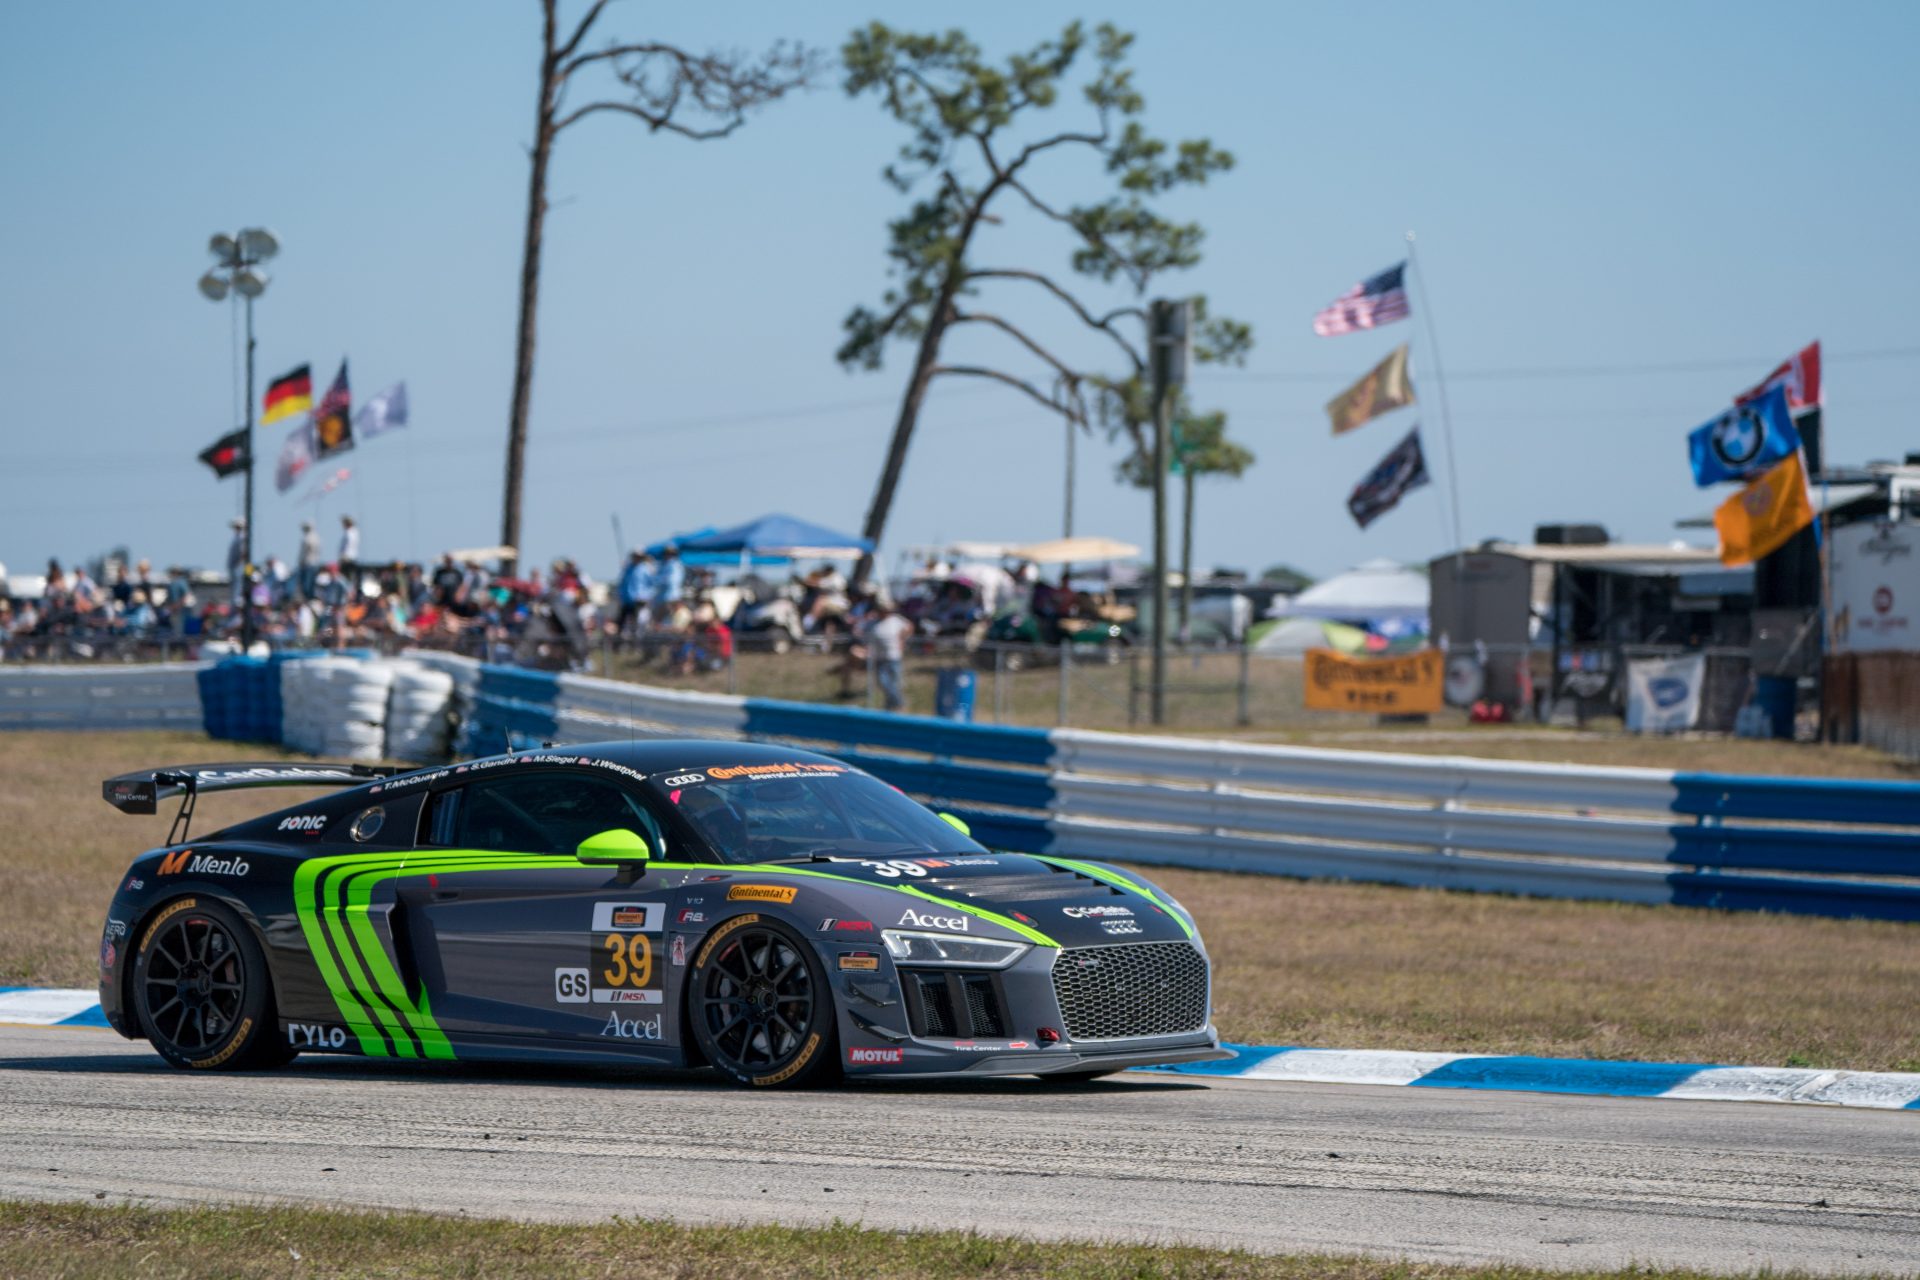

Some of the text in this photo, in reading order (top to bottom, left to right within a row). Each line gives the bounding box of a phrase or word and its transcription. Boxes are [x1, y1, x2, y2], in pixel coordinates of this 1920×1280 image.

[591, 759, 647, 781] J.Westphal
[187, 855, 250, 877] Menlo
[860, 859, 928, 878] 39
[728, 886, 784, 899] Continental
[896, 908, 969, 932] Accel
[603, 932, 653, 988] 39
[558, 973, 588, 998] GS
[600, 1010, 664, 1040] Accel
[851, 1050, 901, 1062] MOTUL
